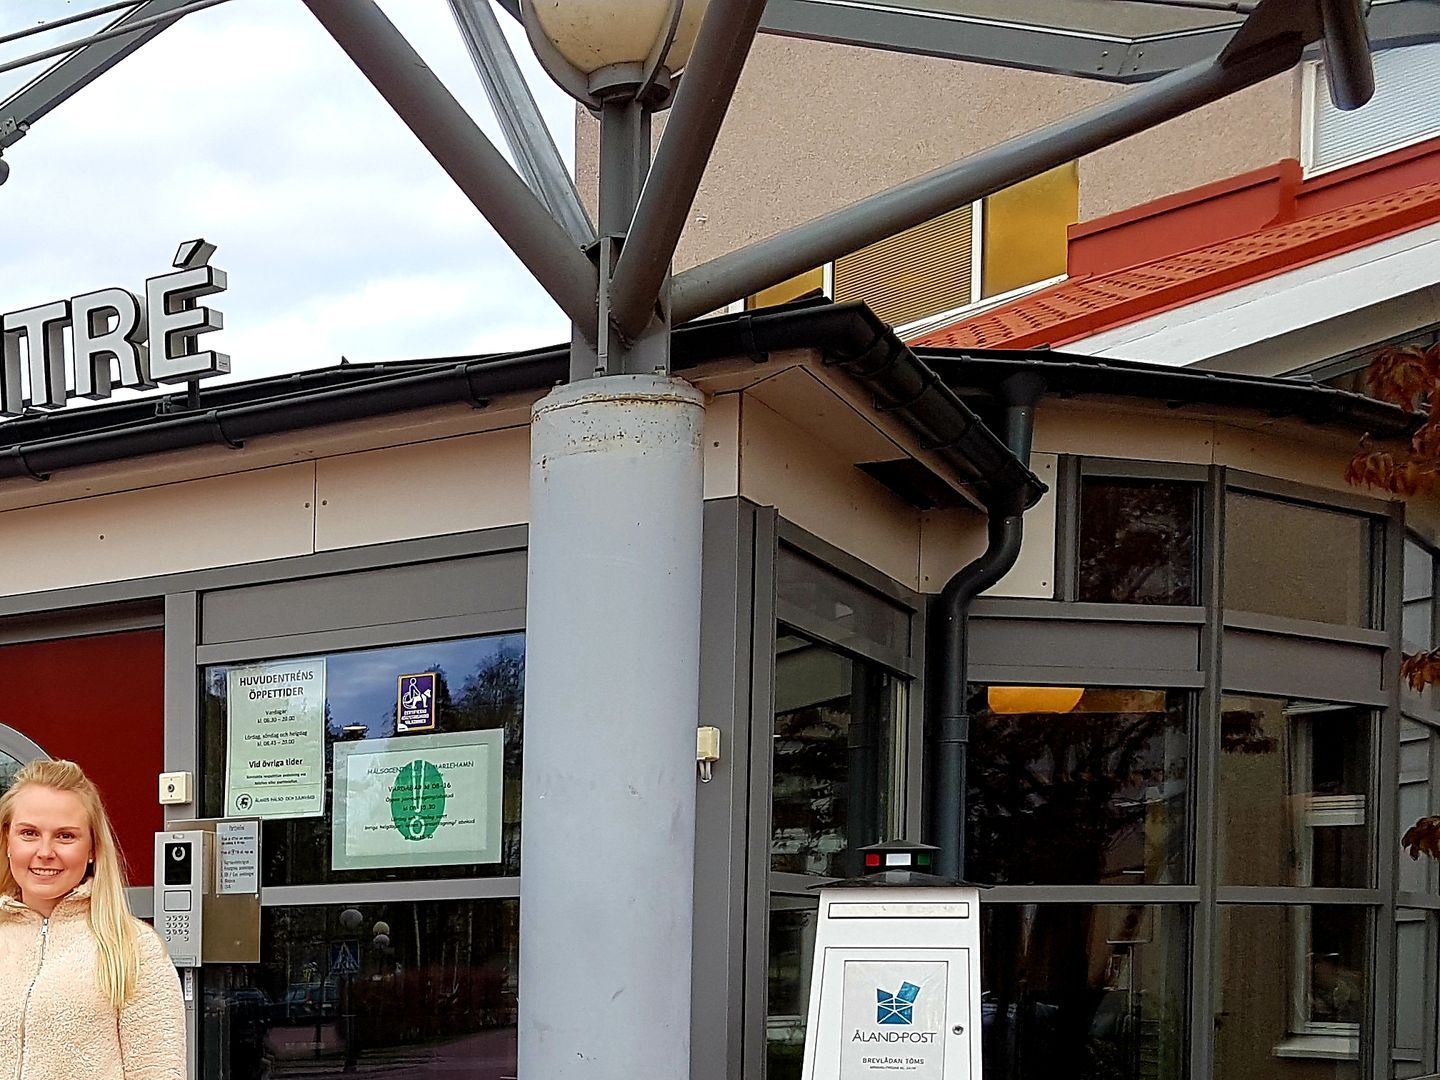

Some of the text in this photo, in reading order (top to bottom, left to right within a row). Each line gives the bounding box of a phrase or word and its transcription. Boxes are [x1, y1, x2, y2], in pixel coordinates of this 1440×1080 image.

[240, 670, 314, 687] HUVUDENTRÉNS
[248, 687, 304, 700] ÖPPETTIDER
[248, 758, 303, 768] Vid övriga tider
[862, 1056, 903, 1065] BREVLÅDAN
